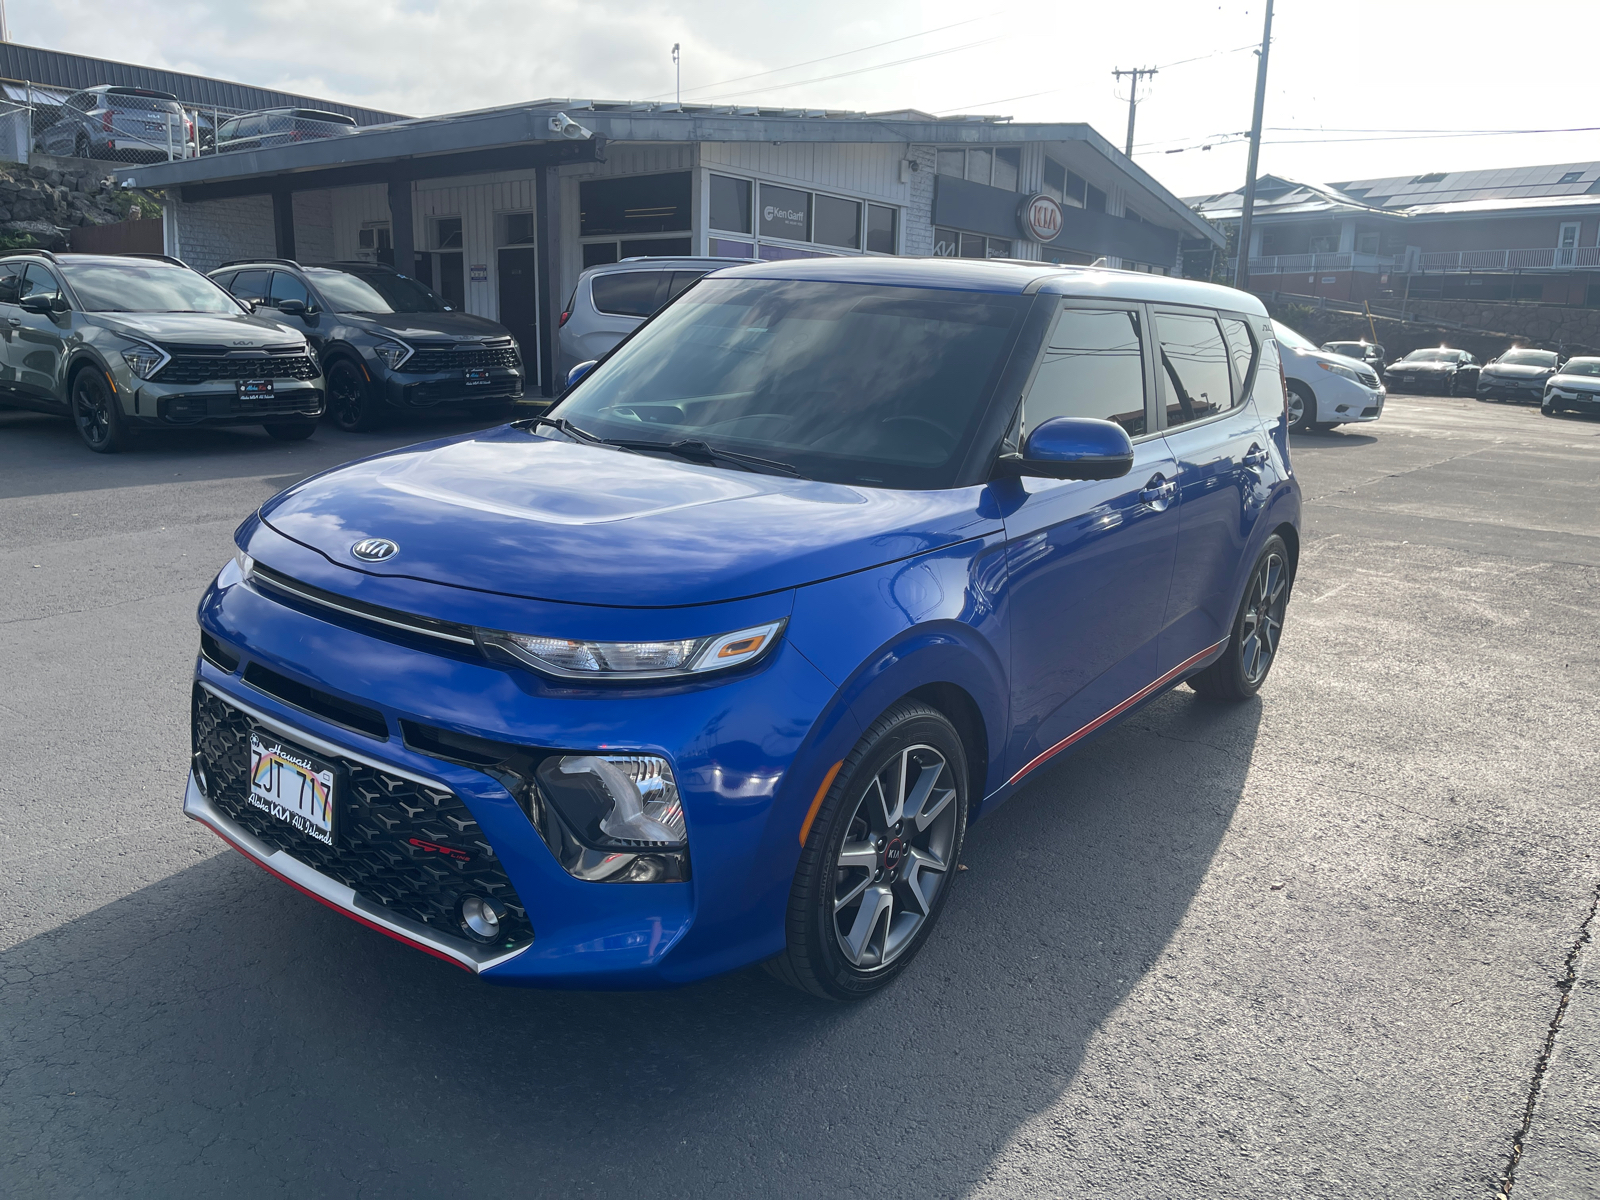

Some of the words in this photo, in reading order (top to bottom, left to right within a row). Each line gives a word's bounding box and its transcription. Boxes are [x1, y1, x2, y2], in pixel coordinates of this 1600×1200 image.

[774, 207, 787, 218] Ken
[788, 210, 804, 221] Garff
[1034, 205, 1058, 230] KIA
[356, 540, 389, 557] KIA
[269, 744, 312, 770] Hawaii
[252, 749, 284, 799] ZJT
[296, 770, 331, 822] 717
[248, 793, 269, 812] Aloha
[292, 815, 304, 831] All
[305, 821, 333, 846] Islands
[451, 853, 470, 862] LINE
[888, 849, 900, 859] KIA
